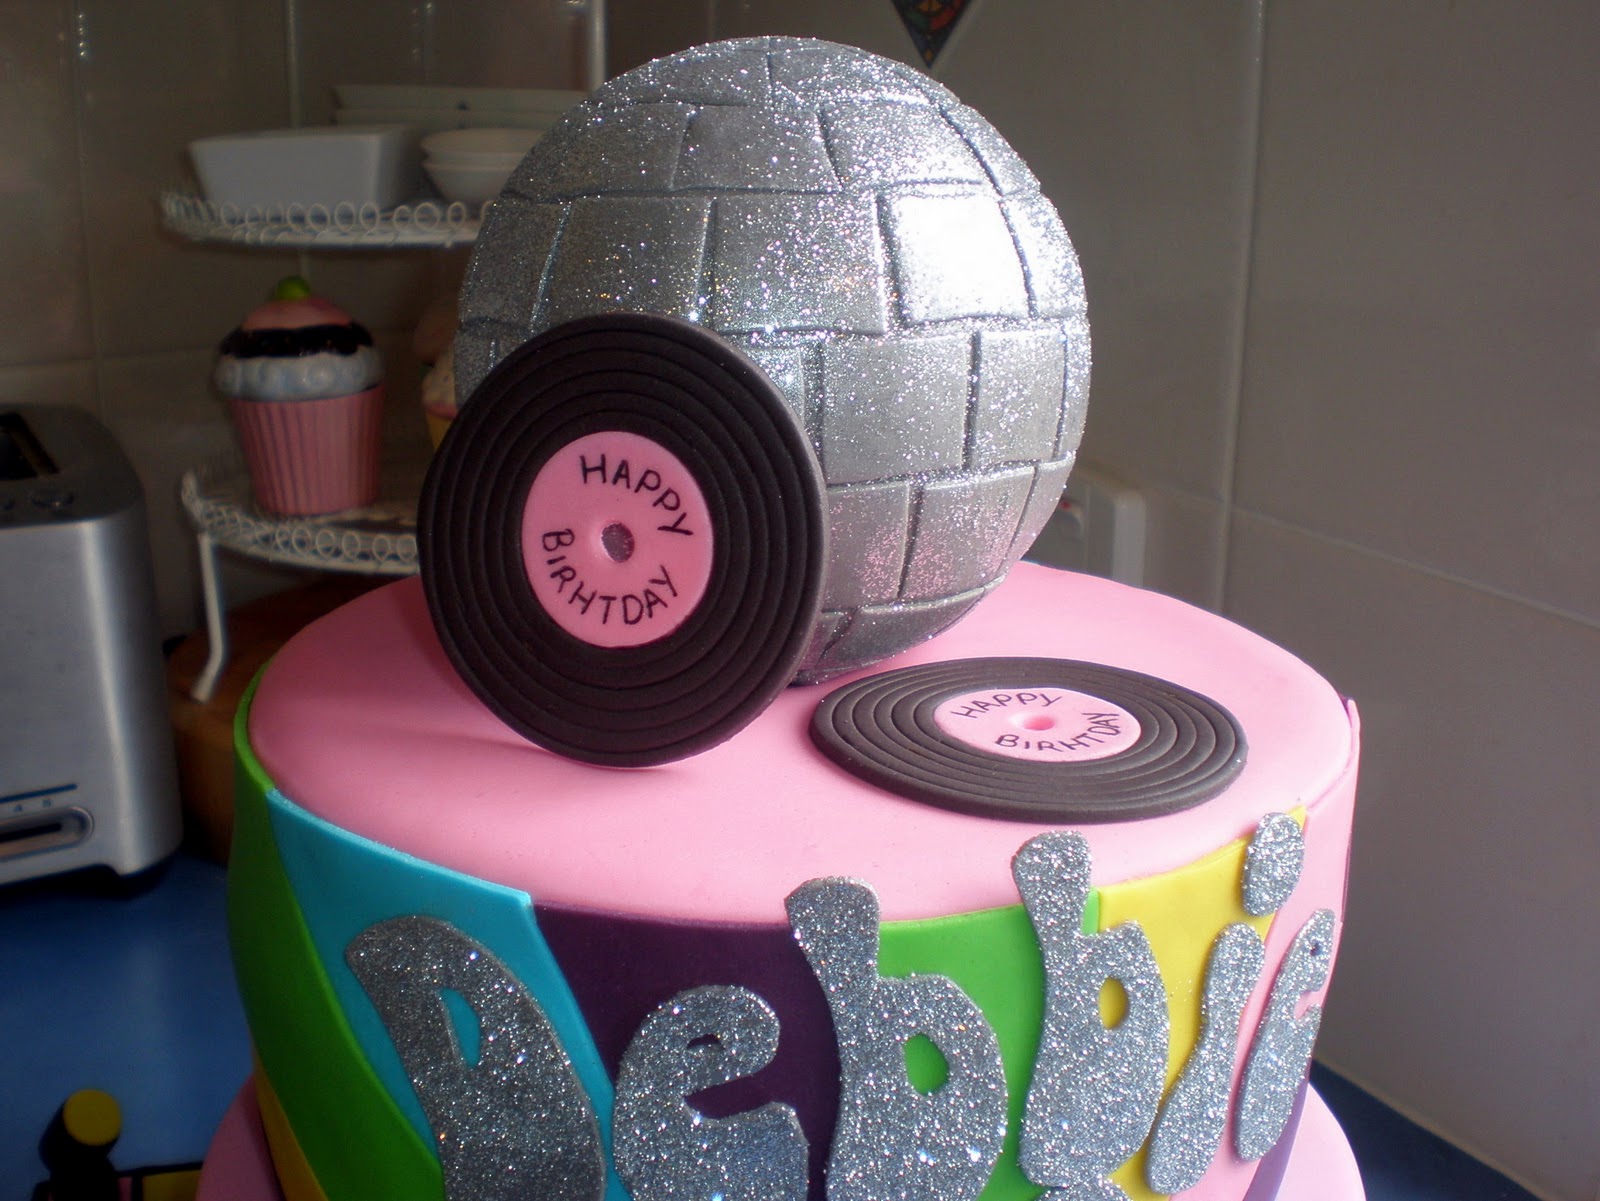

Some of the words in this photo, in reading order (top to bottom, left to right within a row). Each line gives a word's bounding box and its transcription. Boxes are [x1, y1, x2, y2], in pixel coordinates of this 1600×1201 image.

[579, 453, 694, 536] HAPPY
[541, 528, 678, 625] BIRHTDAY
[950, 692, 1063, 719] HAPPY
[994, 712, 1122, 752] BIRHTDAY
